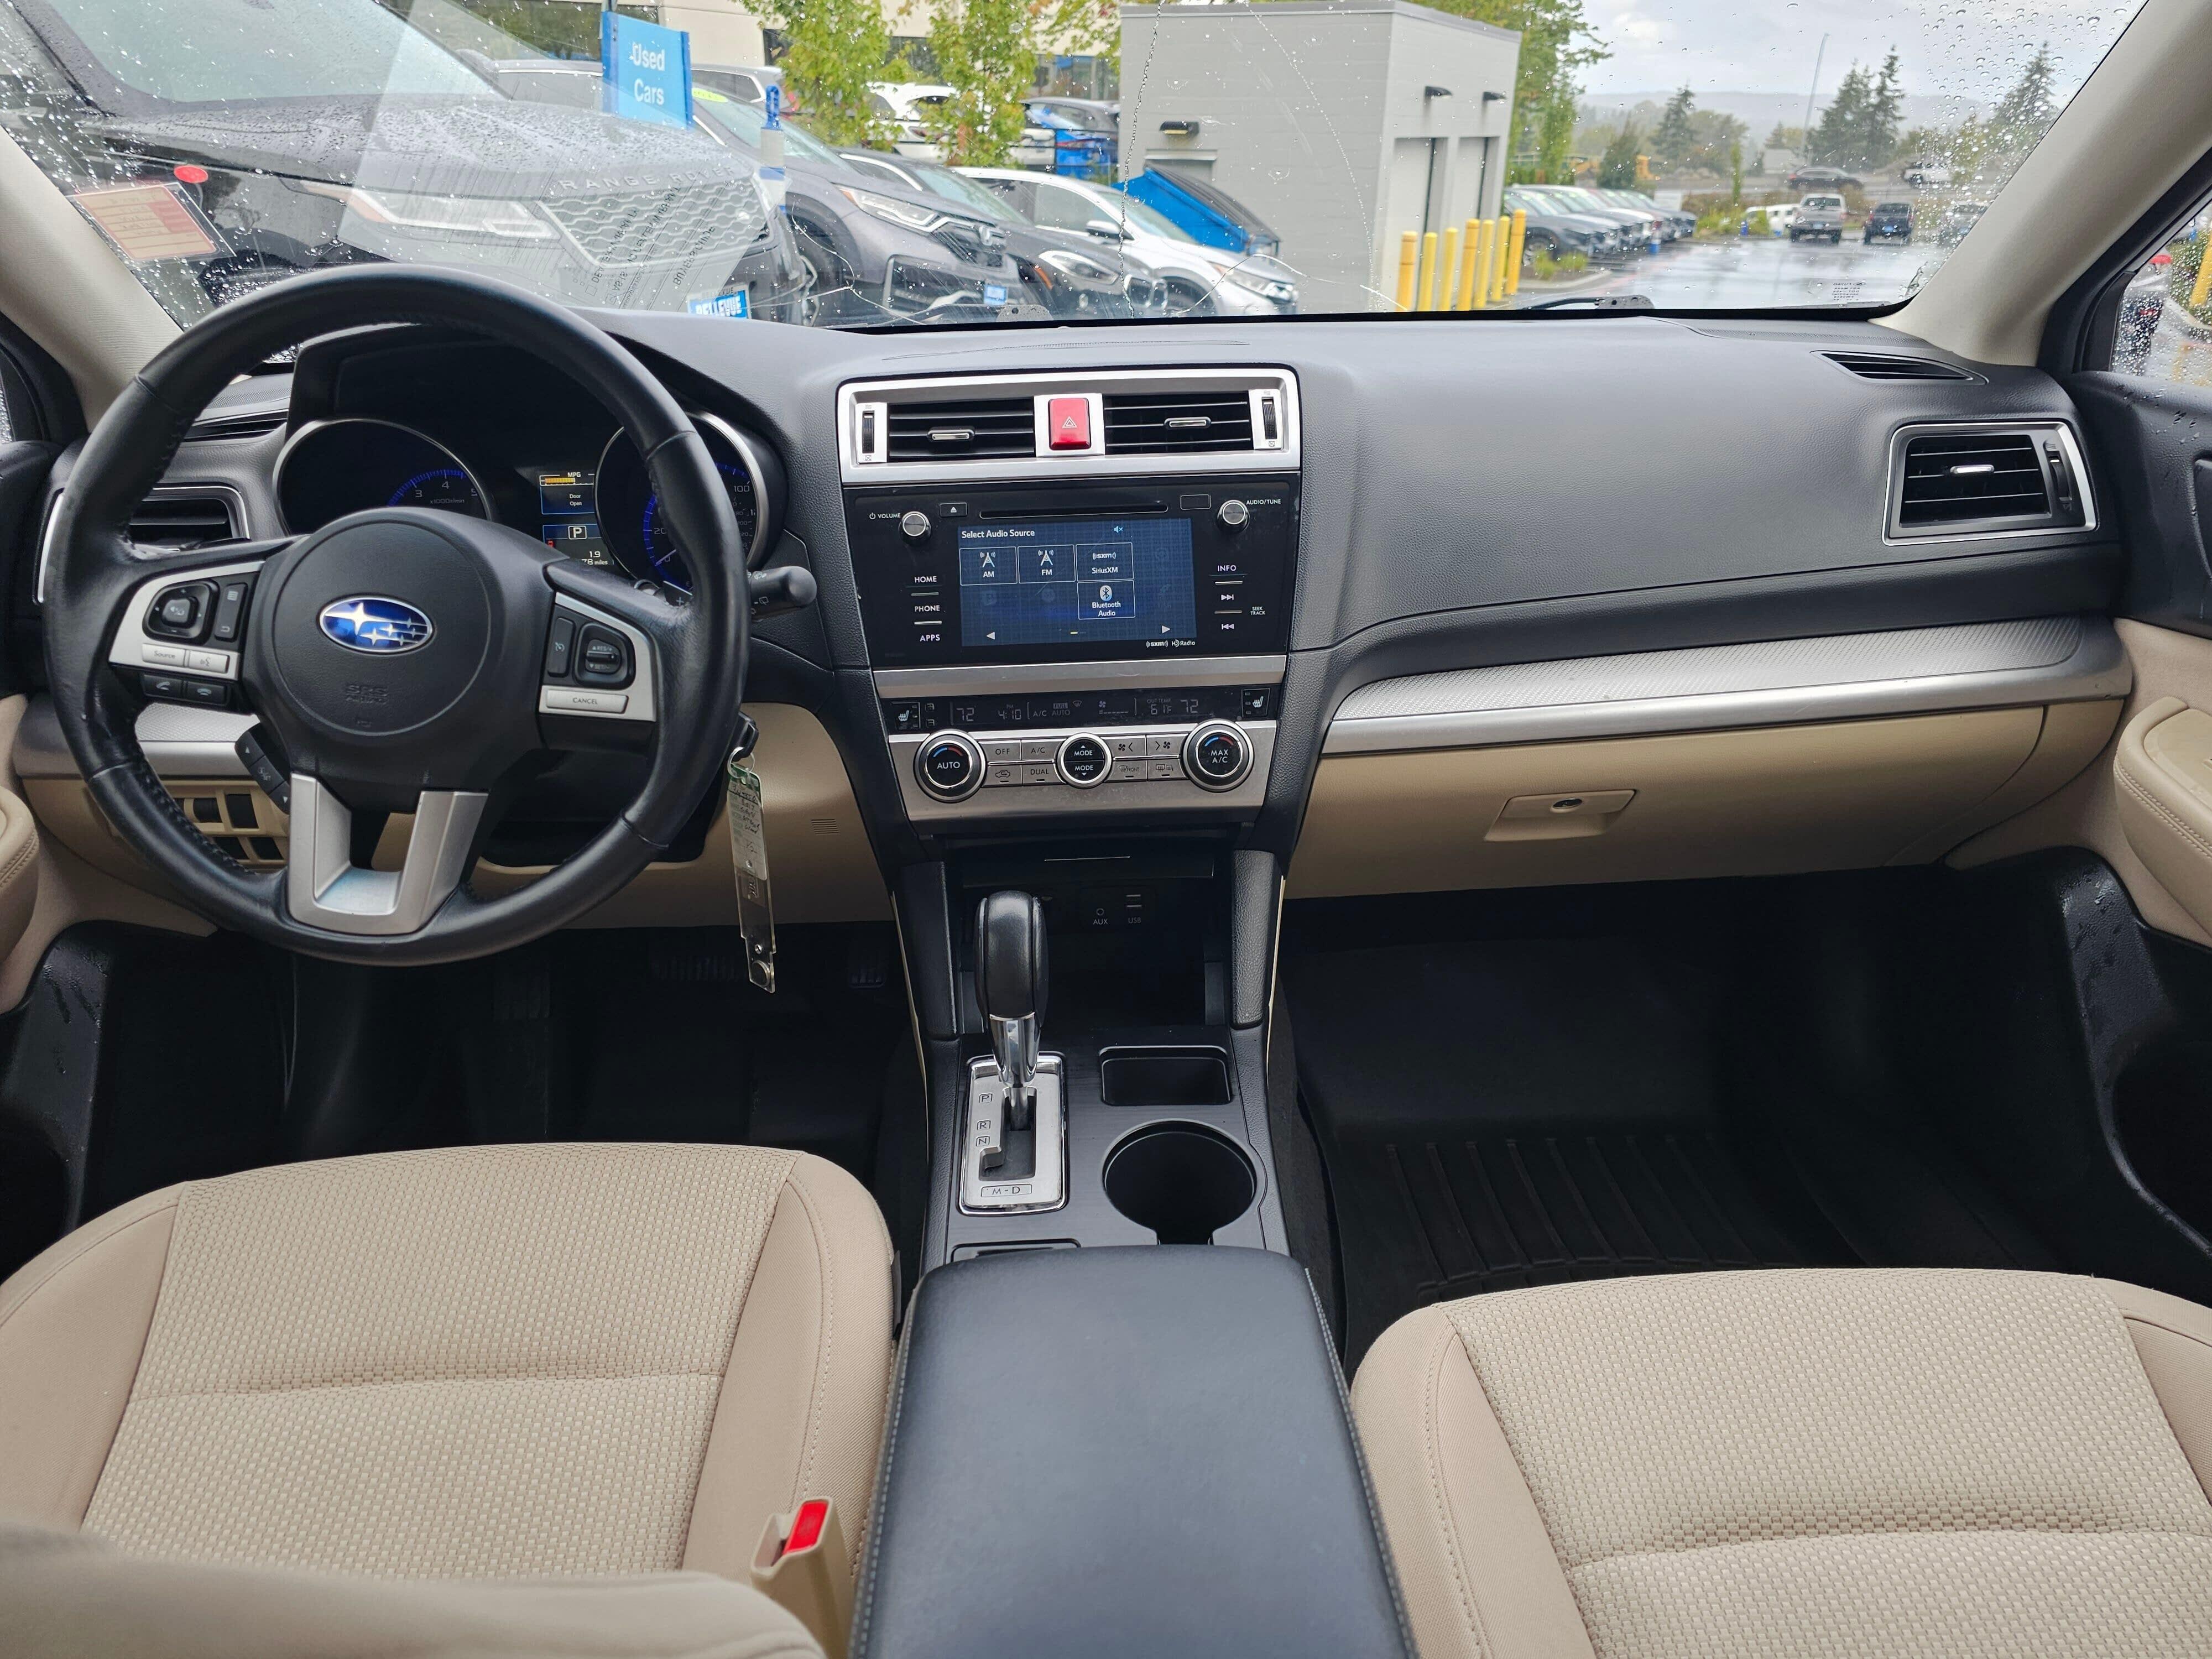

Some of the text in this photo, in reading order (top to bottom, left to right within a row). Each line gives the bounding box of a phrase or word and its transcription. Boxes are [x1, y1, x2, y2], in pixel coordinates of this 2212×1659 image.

[632, 43, 665, 71] Used
[634, 79, 664, 105] Cars
[558, 167, 735, 190] RANGE ROVER
[573, 527, 582, 538] P
[154, 650, 175, 659] Source
[1180, 699, 1198, 713] 72
[956, 708, 974, 721] 72
[998, 709, 1021, 720] 4:10
